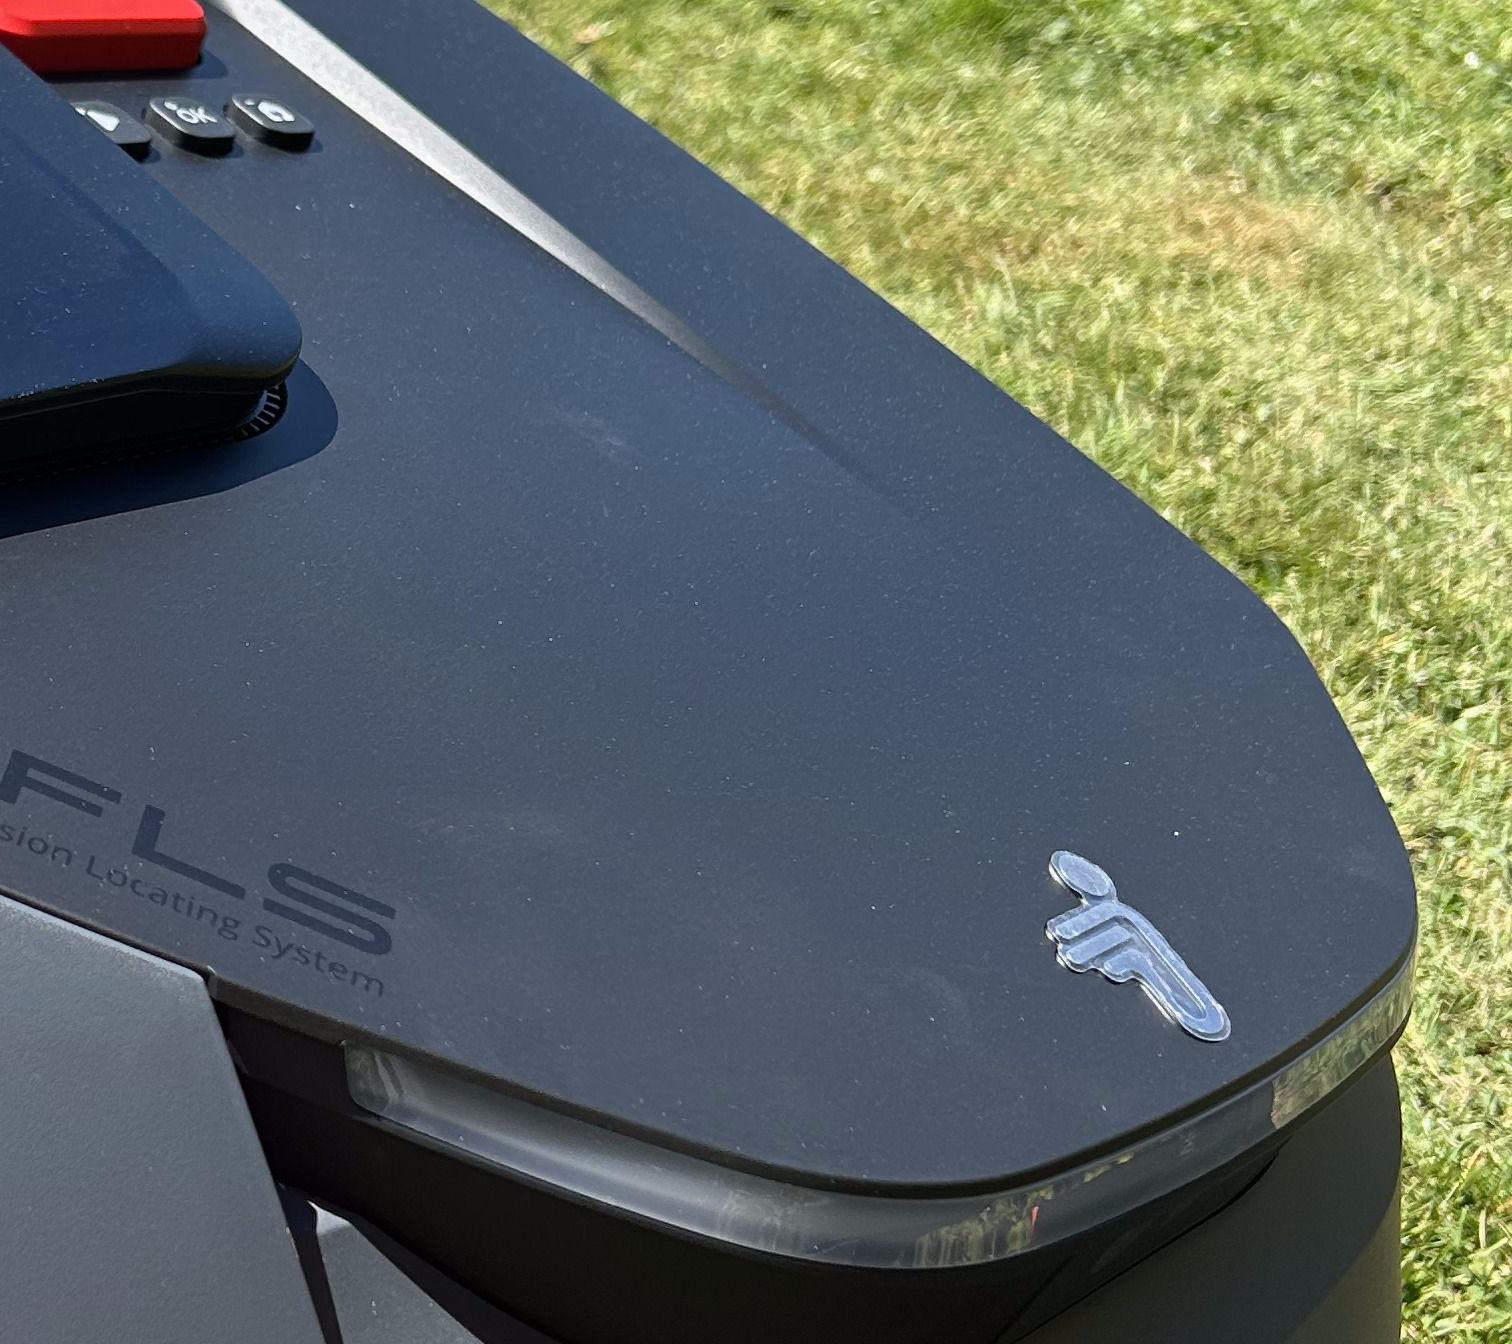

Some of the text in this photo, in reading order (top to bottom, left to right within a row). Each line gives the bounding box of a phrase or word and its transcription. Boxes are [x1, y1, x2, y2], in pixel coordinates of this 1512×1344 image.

[175, 104, 219, 126] OK
[84, 852, 241, 942] Locating
[250, 923, 386, 999] System
